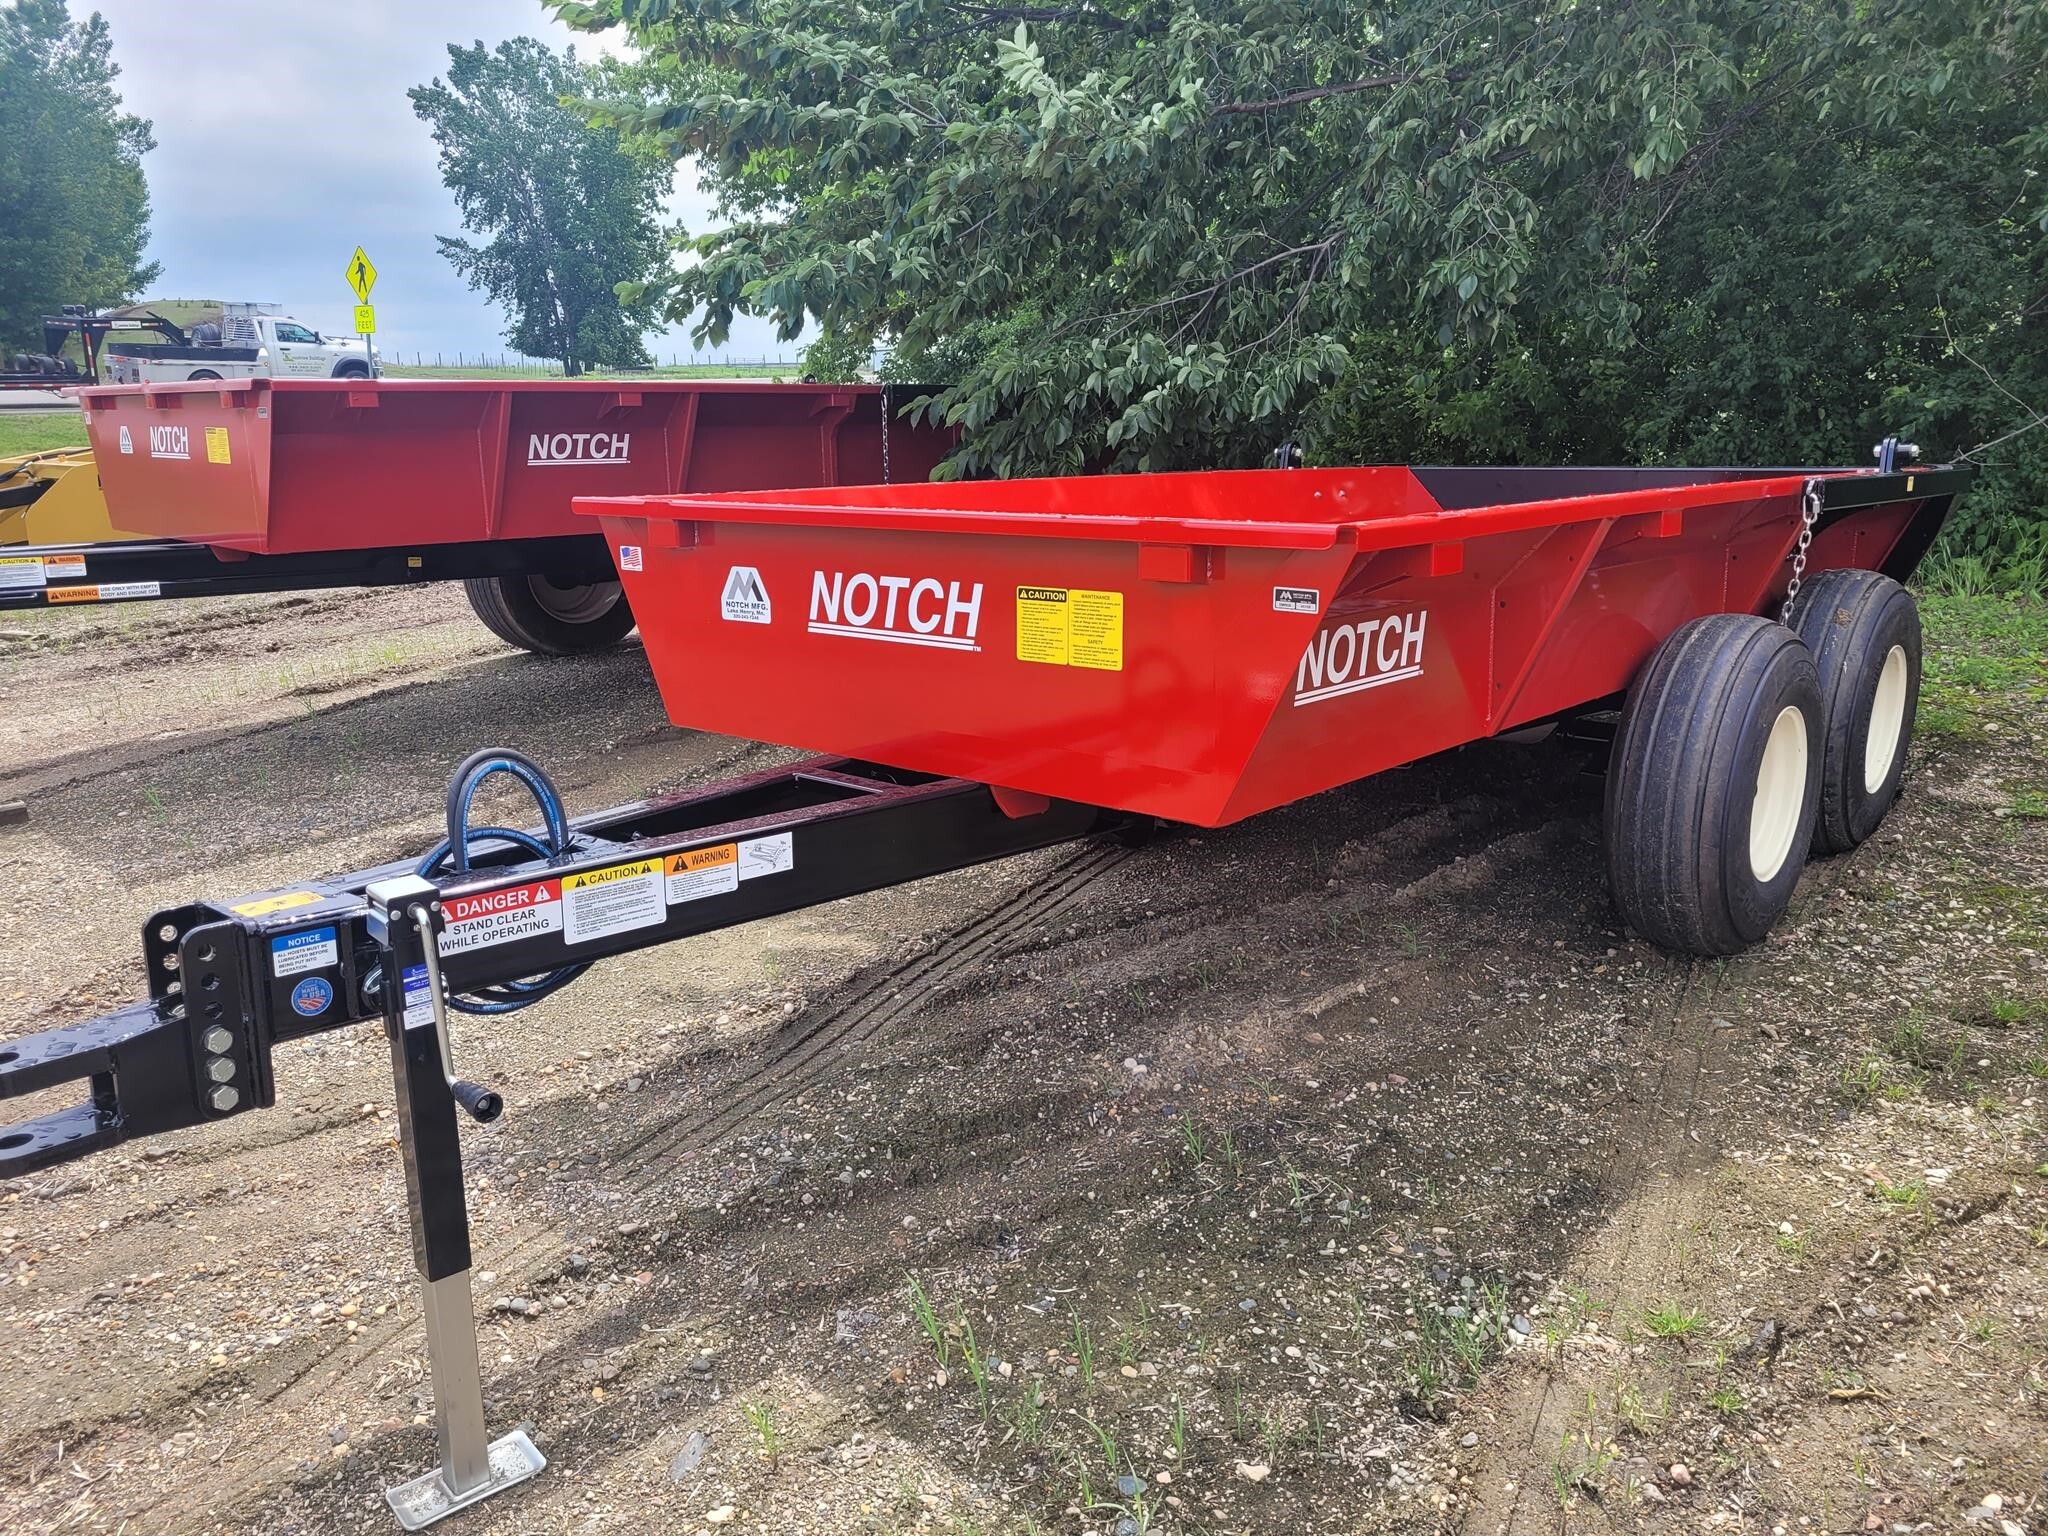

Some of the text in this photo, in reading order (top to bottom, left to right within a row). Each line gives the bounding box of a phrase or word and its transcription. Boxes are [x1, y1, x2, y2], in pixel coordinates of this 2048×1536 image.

[360, 310, 370, 318] 425
[358, 320, 372, 329] FEET
[150, 426, 189, 452] NOTCH
[528, 433, 630, 459] NOTCH
[59, 589, 98, 599] WARNING
[1028, 590, 1066, 600] CAUTION
[726, 600, 769, 611] NOTCH MFG.
[809, 570, 983, 637] NOTCH
[1296, 610, 1428, 692] NOTCH
[691, 848, 730, 866] WARNING
[589, 866, 638, 884] CAUTION
[456, 890, 530, 918] DANGER
[453, 908, 536, 935] STAND CLEAR
[288, 933, 321, 947] NOTICE
[440, 918, 550, 952] WHILE OPERATING
[277, 948, 329, 963] LUBRICATED BEFORE
[278, 961, 295, 969] BEING
